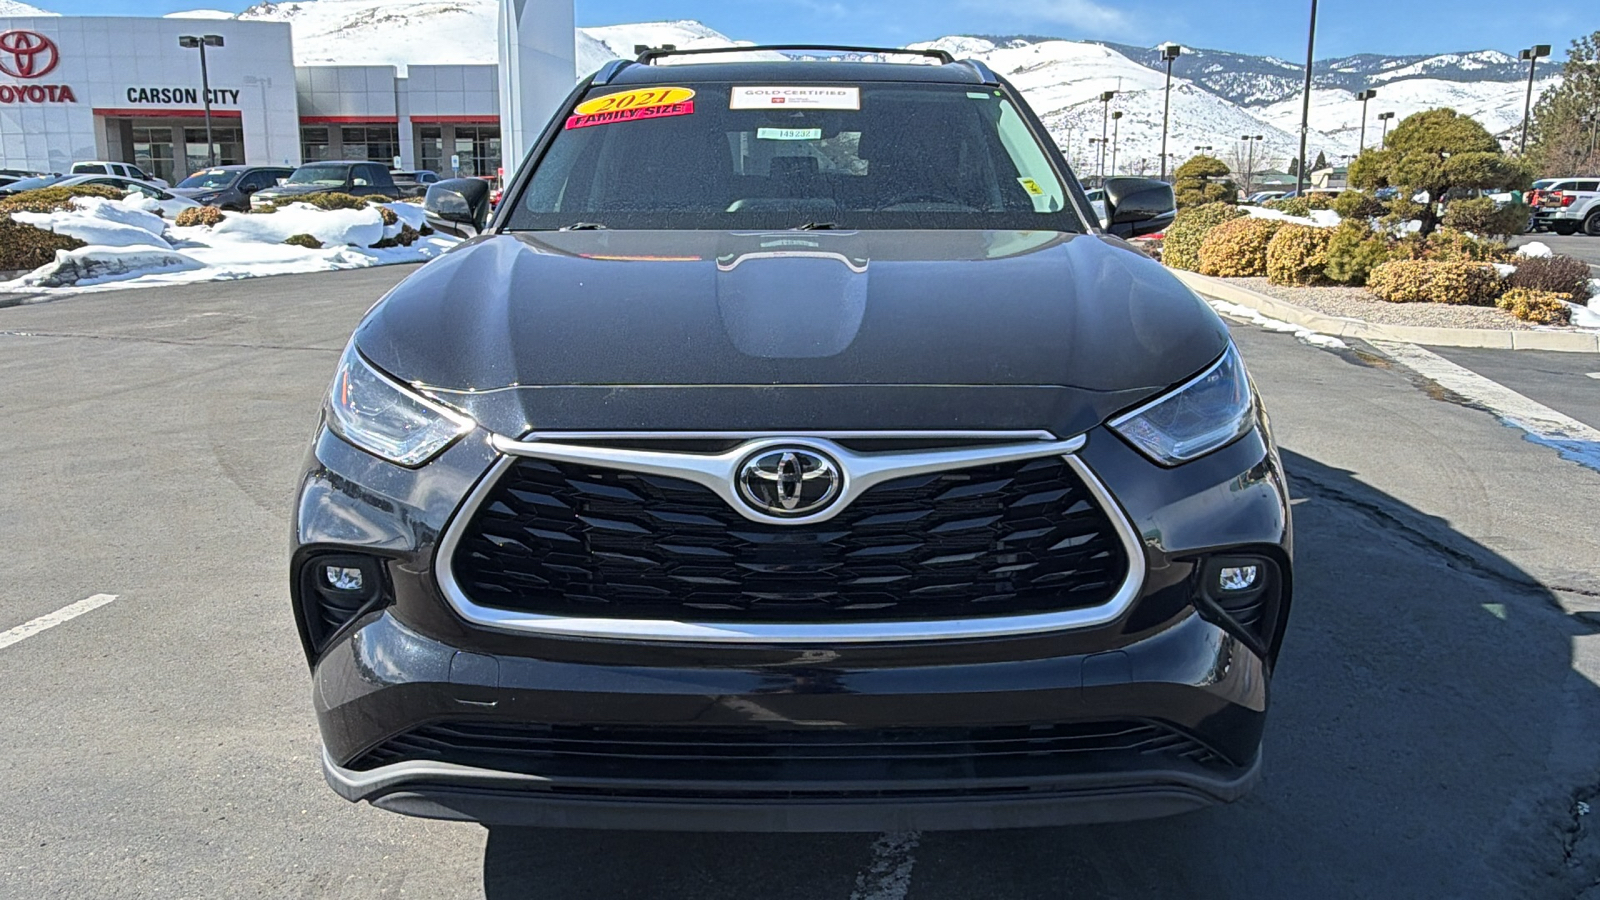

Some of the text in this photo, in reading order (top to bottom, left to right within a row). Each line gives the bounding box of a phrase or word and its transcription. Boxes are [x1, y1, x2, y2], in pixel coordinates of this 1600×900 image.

[0, 85, 77, 103] OYOTA
[127, 87, 240, 105] CARSON CITY
[595, 89, 672, 112] 2021
[575, 103, 685, 125] FAMILY SIZE
